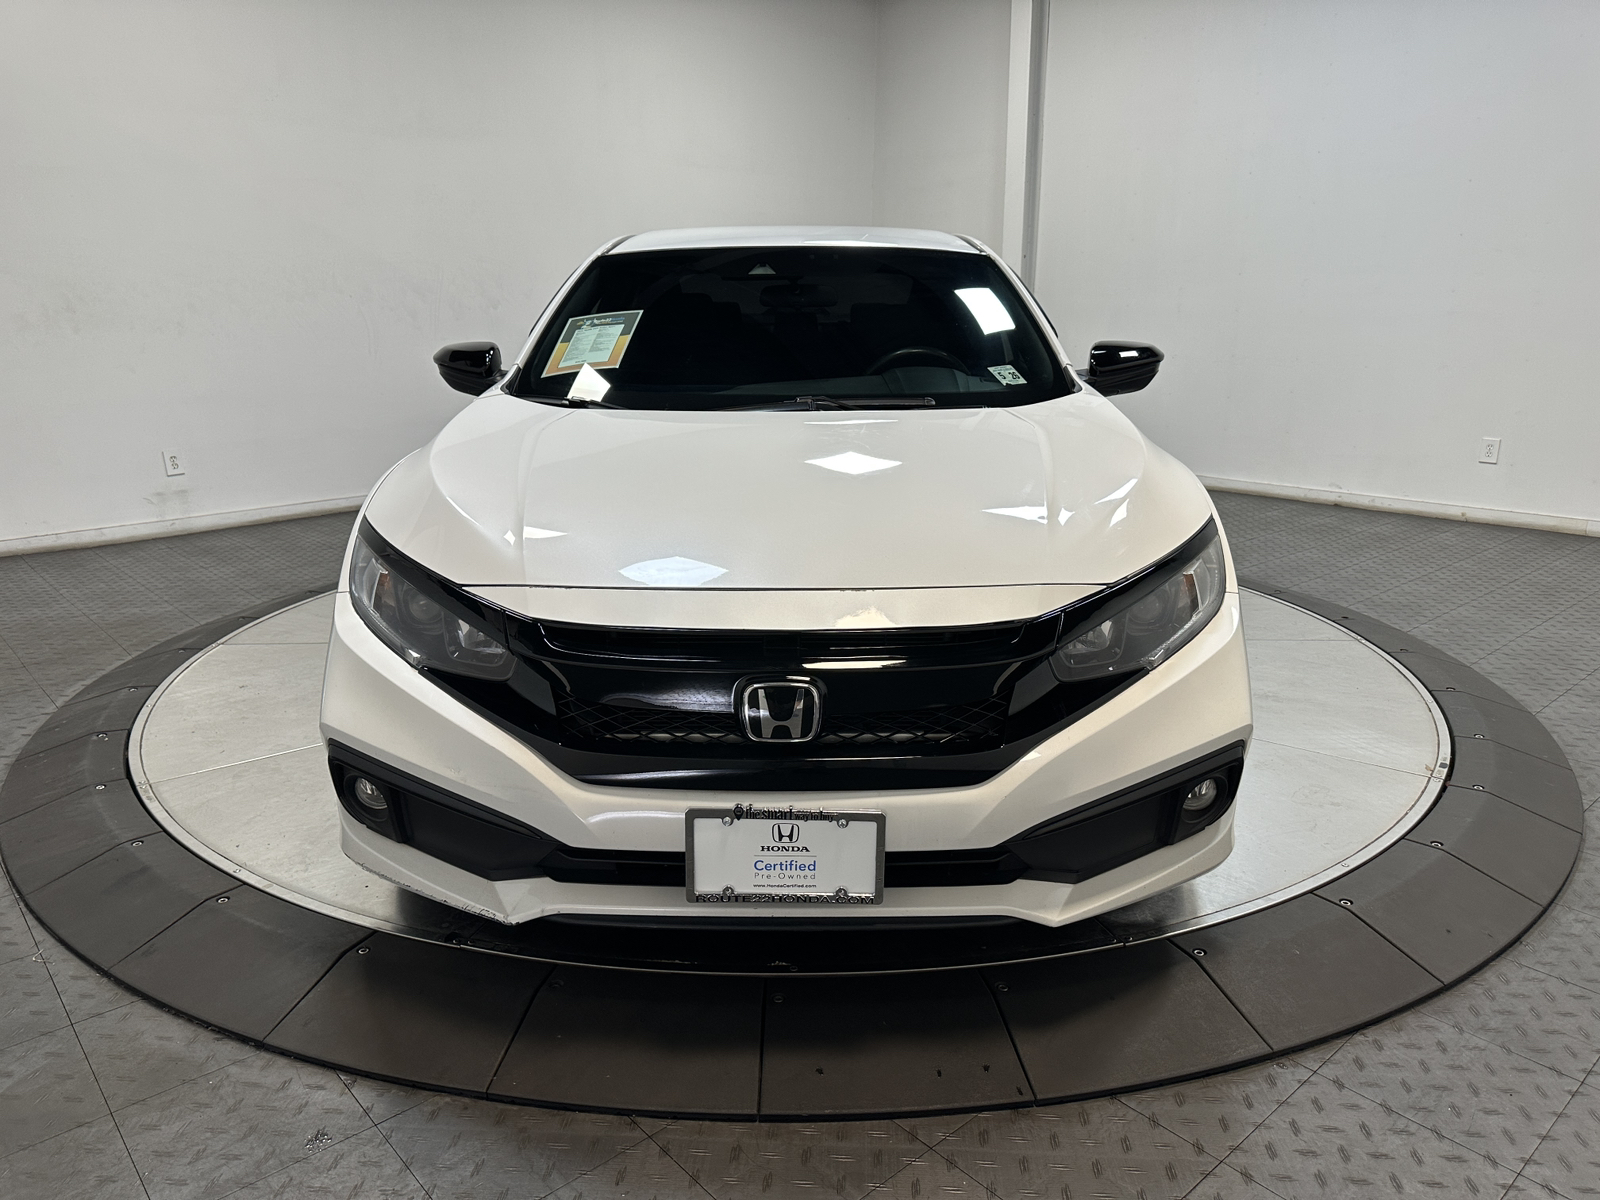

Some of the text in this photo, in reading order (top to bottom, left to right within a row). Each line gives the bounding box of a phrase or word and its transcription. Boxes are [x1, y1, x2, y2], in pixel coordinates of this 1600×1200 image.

[745, 804, 760, 819] the
[761, 805, 793, 820] smart
[794, 810, 810, 822] way
[753, 859, 816, 872] Certified
[695, 894, 875, 904] ROUTE22HONDA.COM
